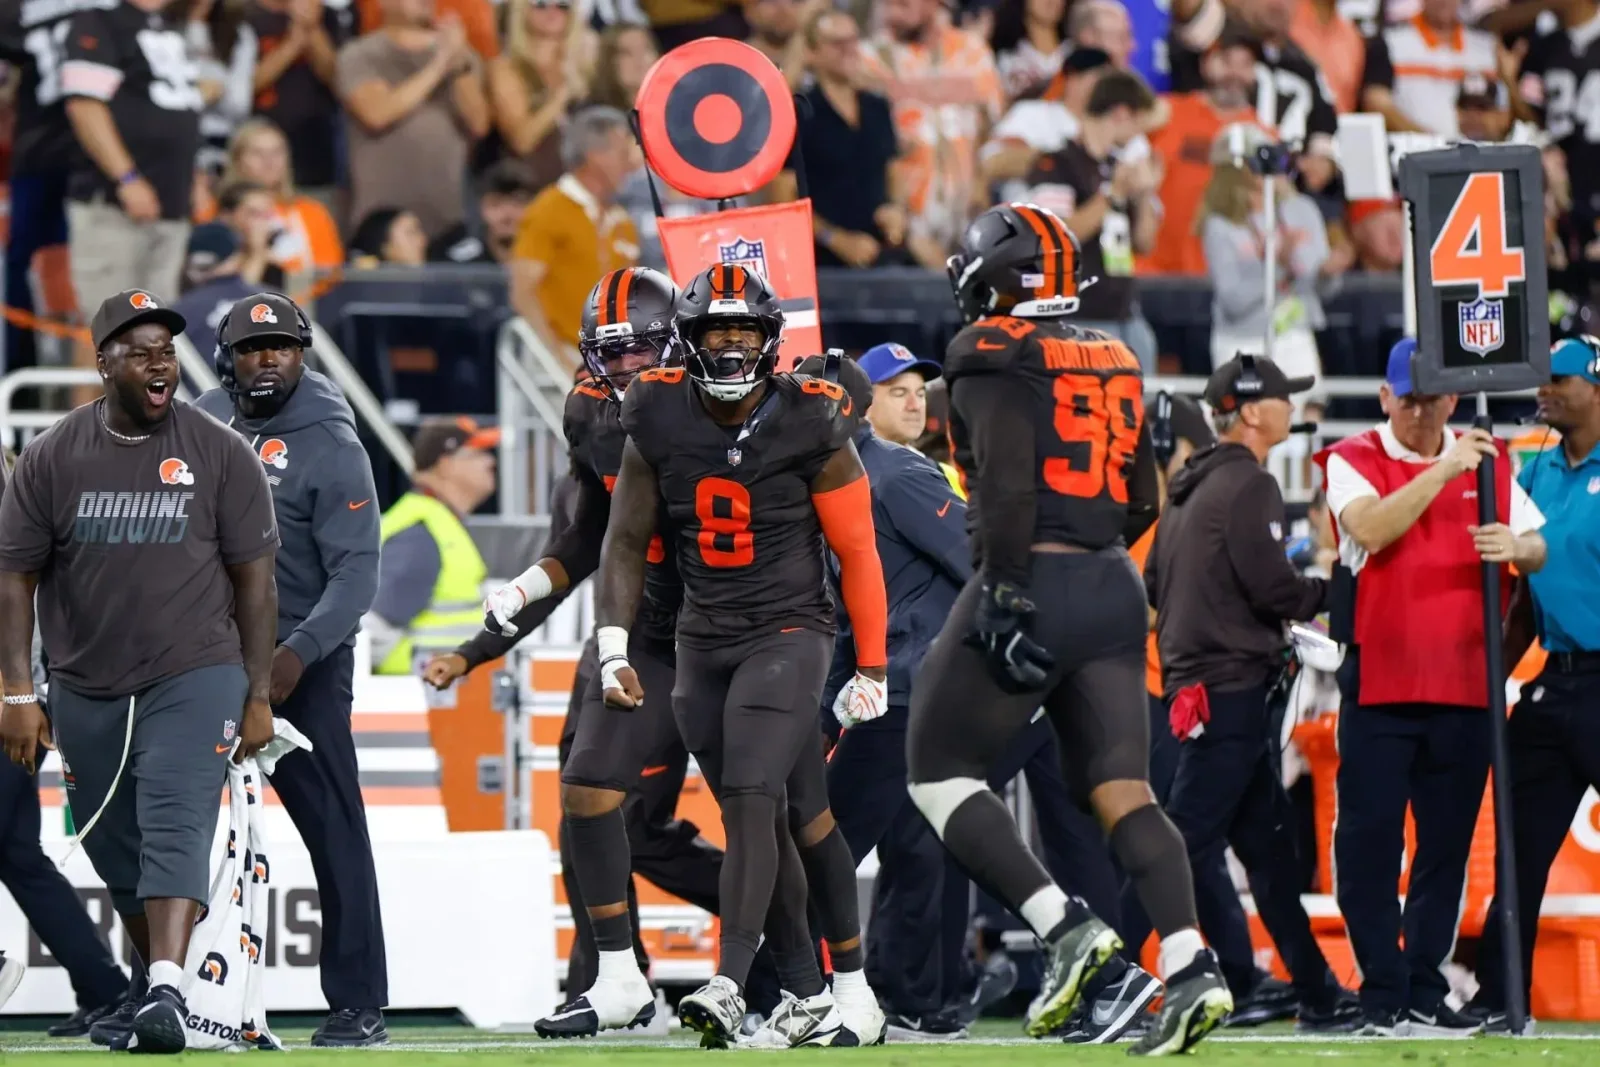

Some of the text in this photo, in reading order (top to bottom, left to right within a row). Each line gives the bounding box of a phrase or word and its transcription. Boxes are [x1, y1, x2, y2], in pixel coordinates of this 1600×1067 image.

[1430, 172, 1525, 297] 4
[1465, 322, 1499, 347] NFL
[1043, 373, 1144, 504] 98
[76, 491, 195, 544] BROWNS
[695, 477, 754, 568] 8
